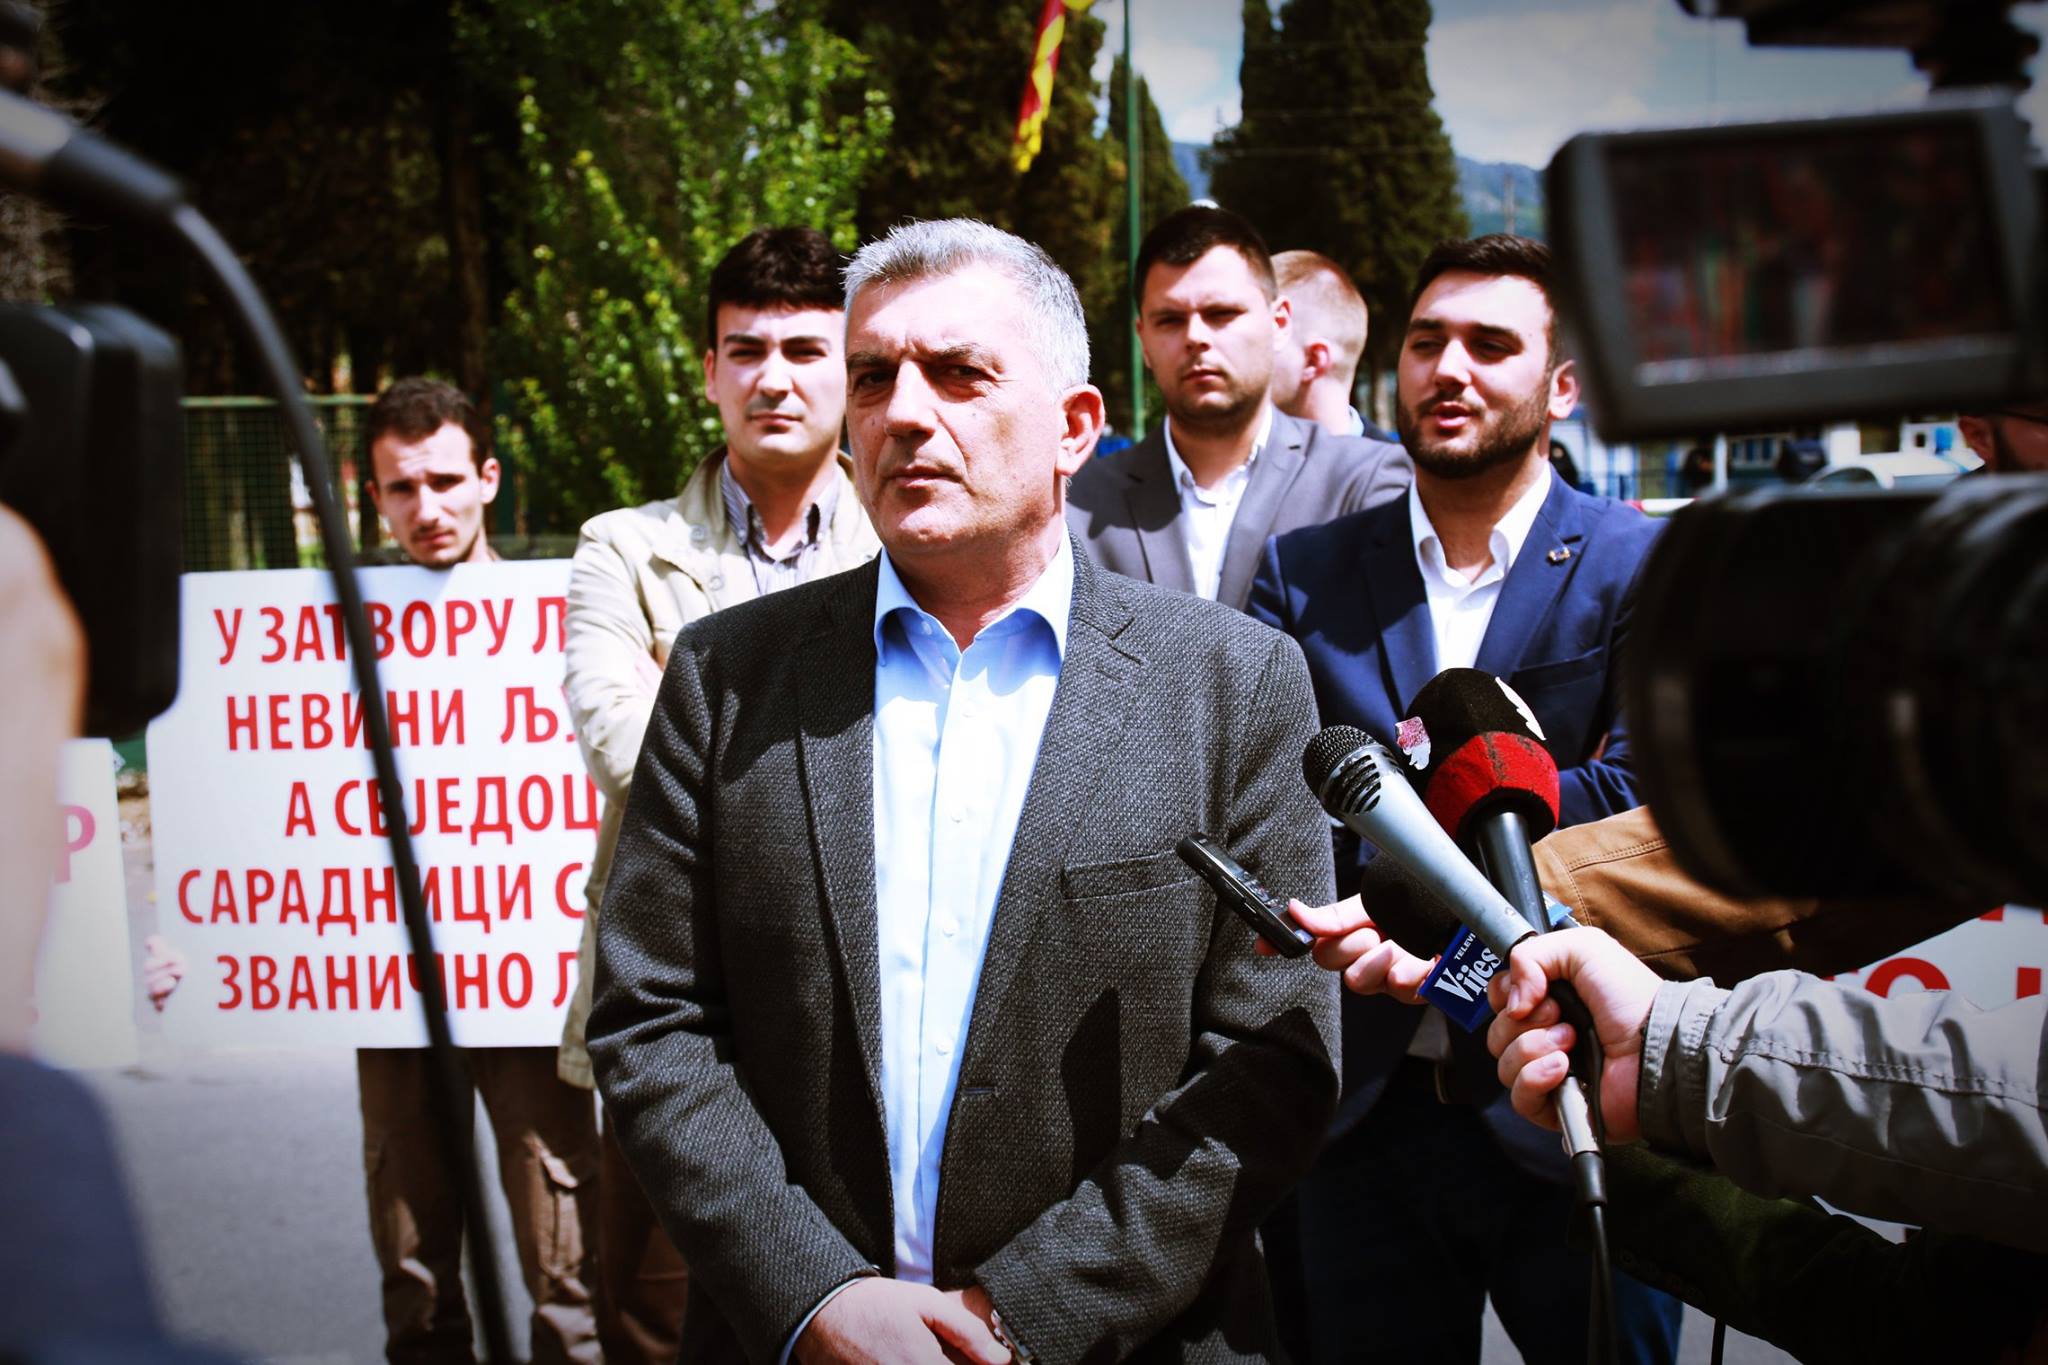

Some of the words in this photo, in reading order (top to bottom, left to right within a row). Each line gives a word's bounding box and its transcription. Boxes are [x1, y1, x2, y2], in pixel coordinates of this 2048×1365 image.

[213, 608, 243, 665] У
[227, 688, 465, 751] НЕВИНИ
[285, 781, 317, 837] А
